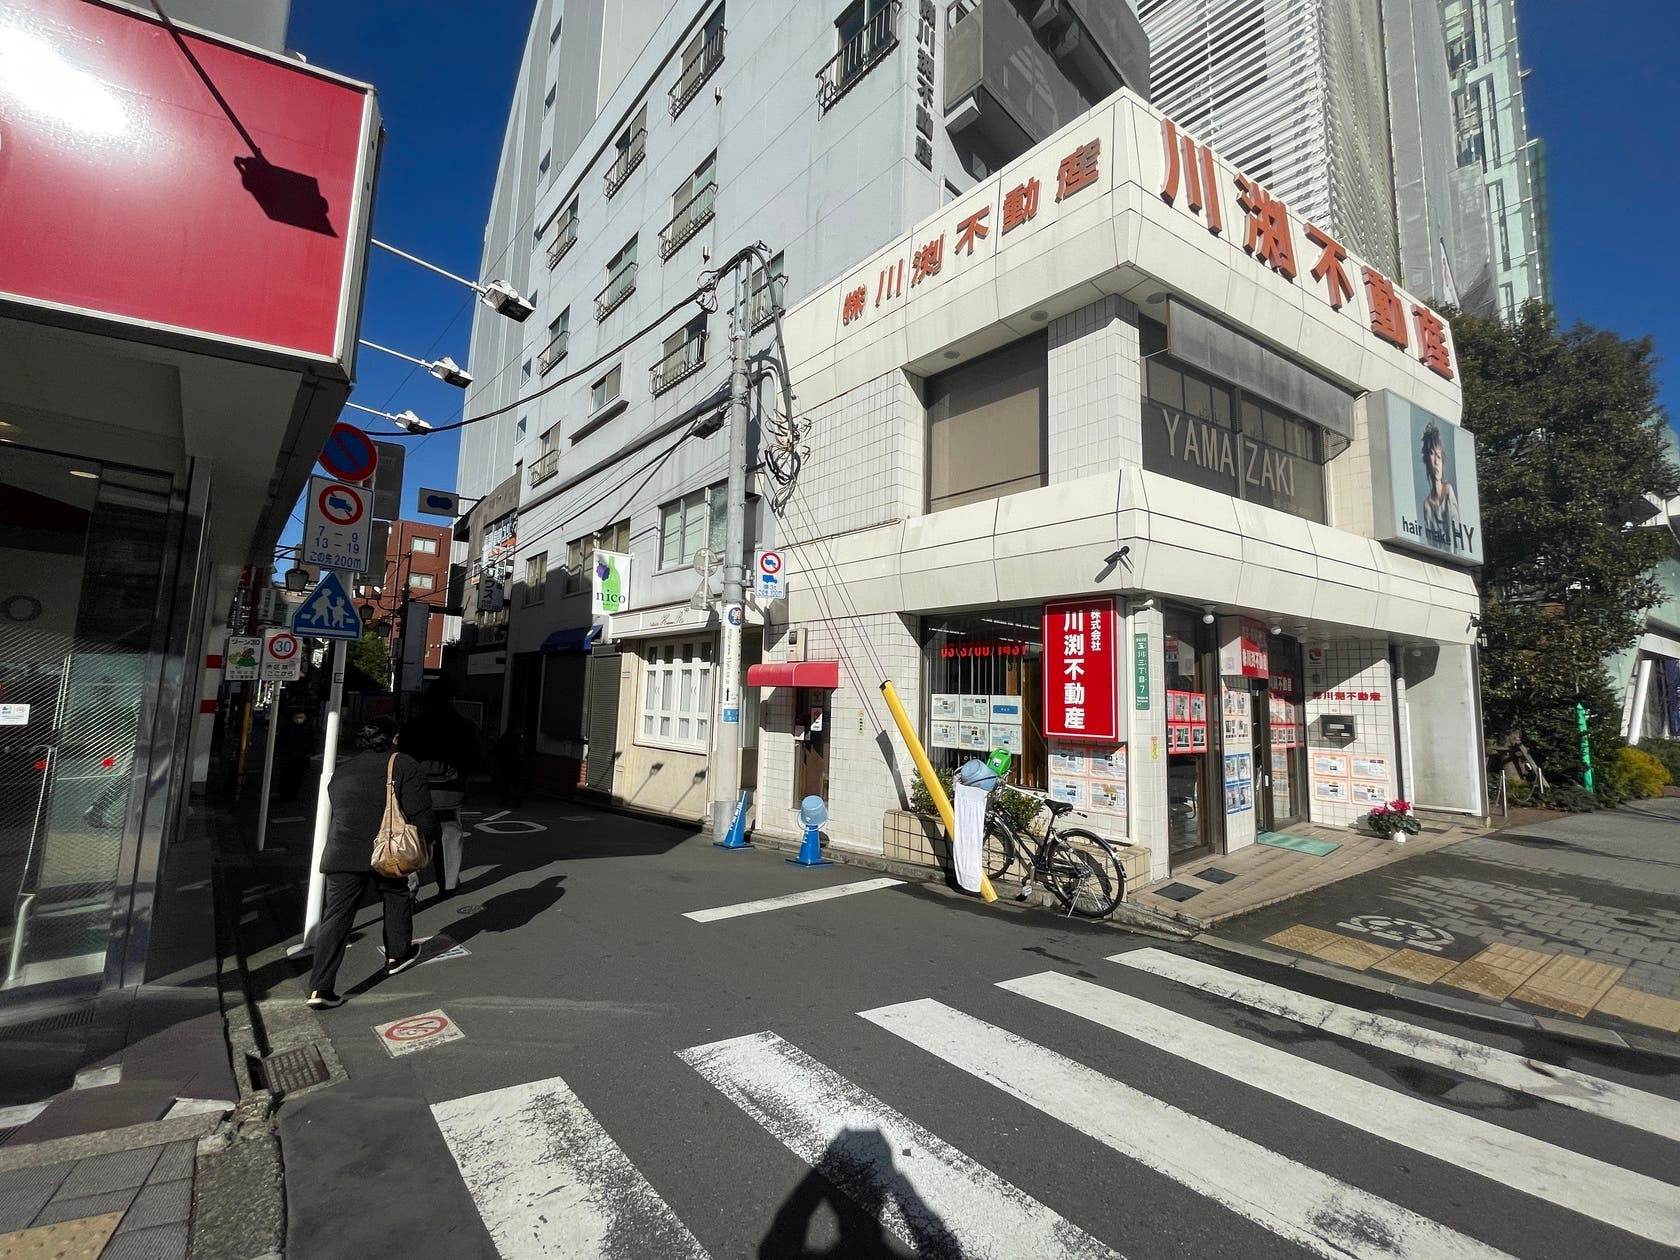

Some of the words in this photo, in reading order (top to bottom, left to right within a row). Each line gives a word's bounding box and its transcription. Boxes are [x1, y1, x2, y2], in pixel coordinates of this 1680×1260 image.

[1160, 117, 1454, 381] 川渕不動産
[1162, 408, 1295, 497] YAMAZAKI
[1402, 516, 1423, 537] hair
[1451, 519, 1475, 554] HY
[310, 552, 362, 570] この先200m
[596, 589, 626, 604] nico
[275, 641, 292, 653] 30
[1090, 608, 1102, 652] 株式会社
[1063, 609, 1086, 730] 川渕不動産
